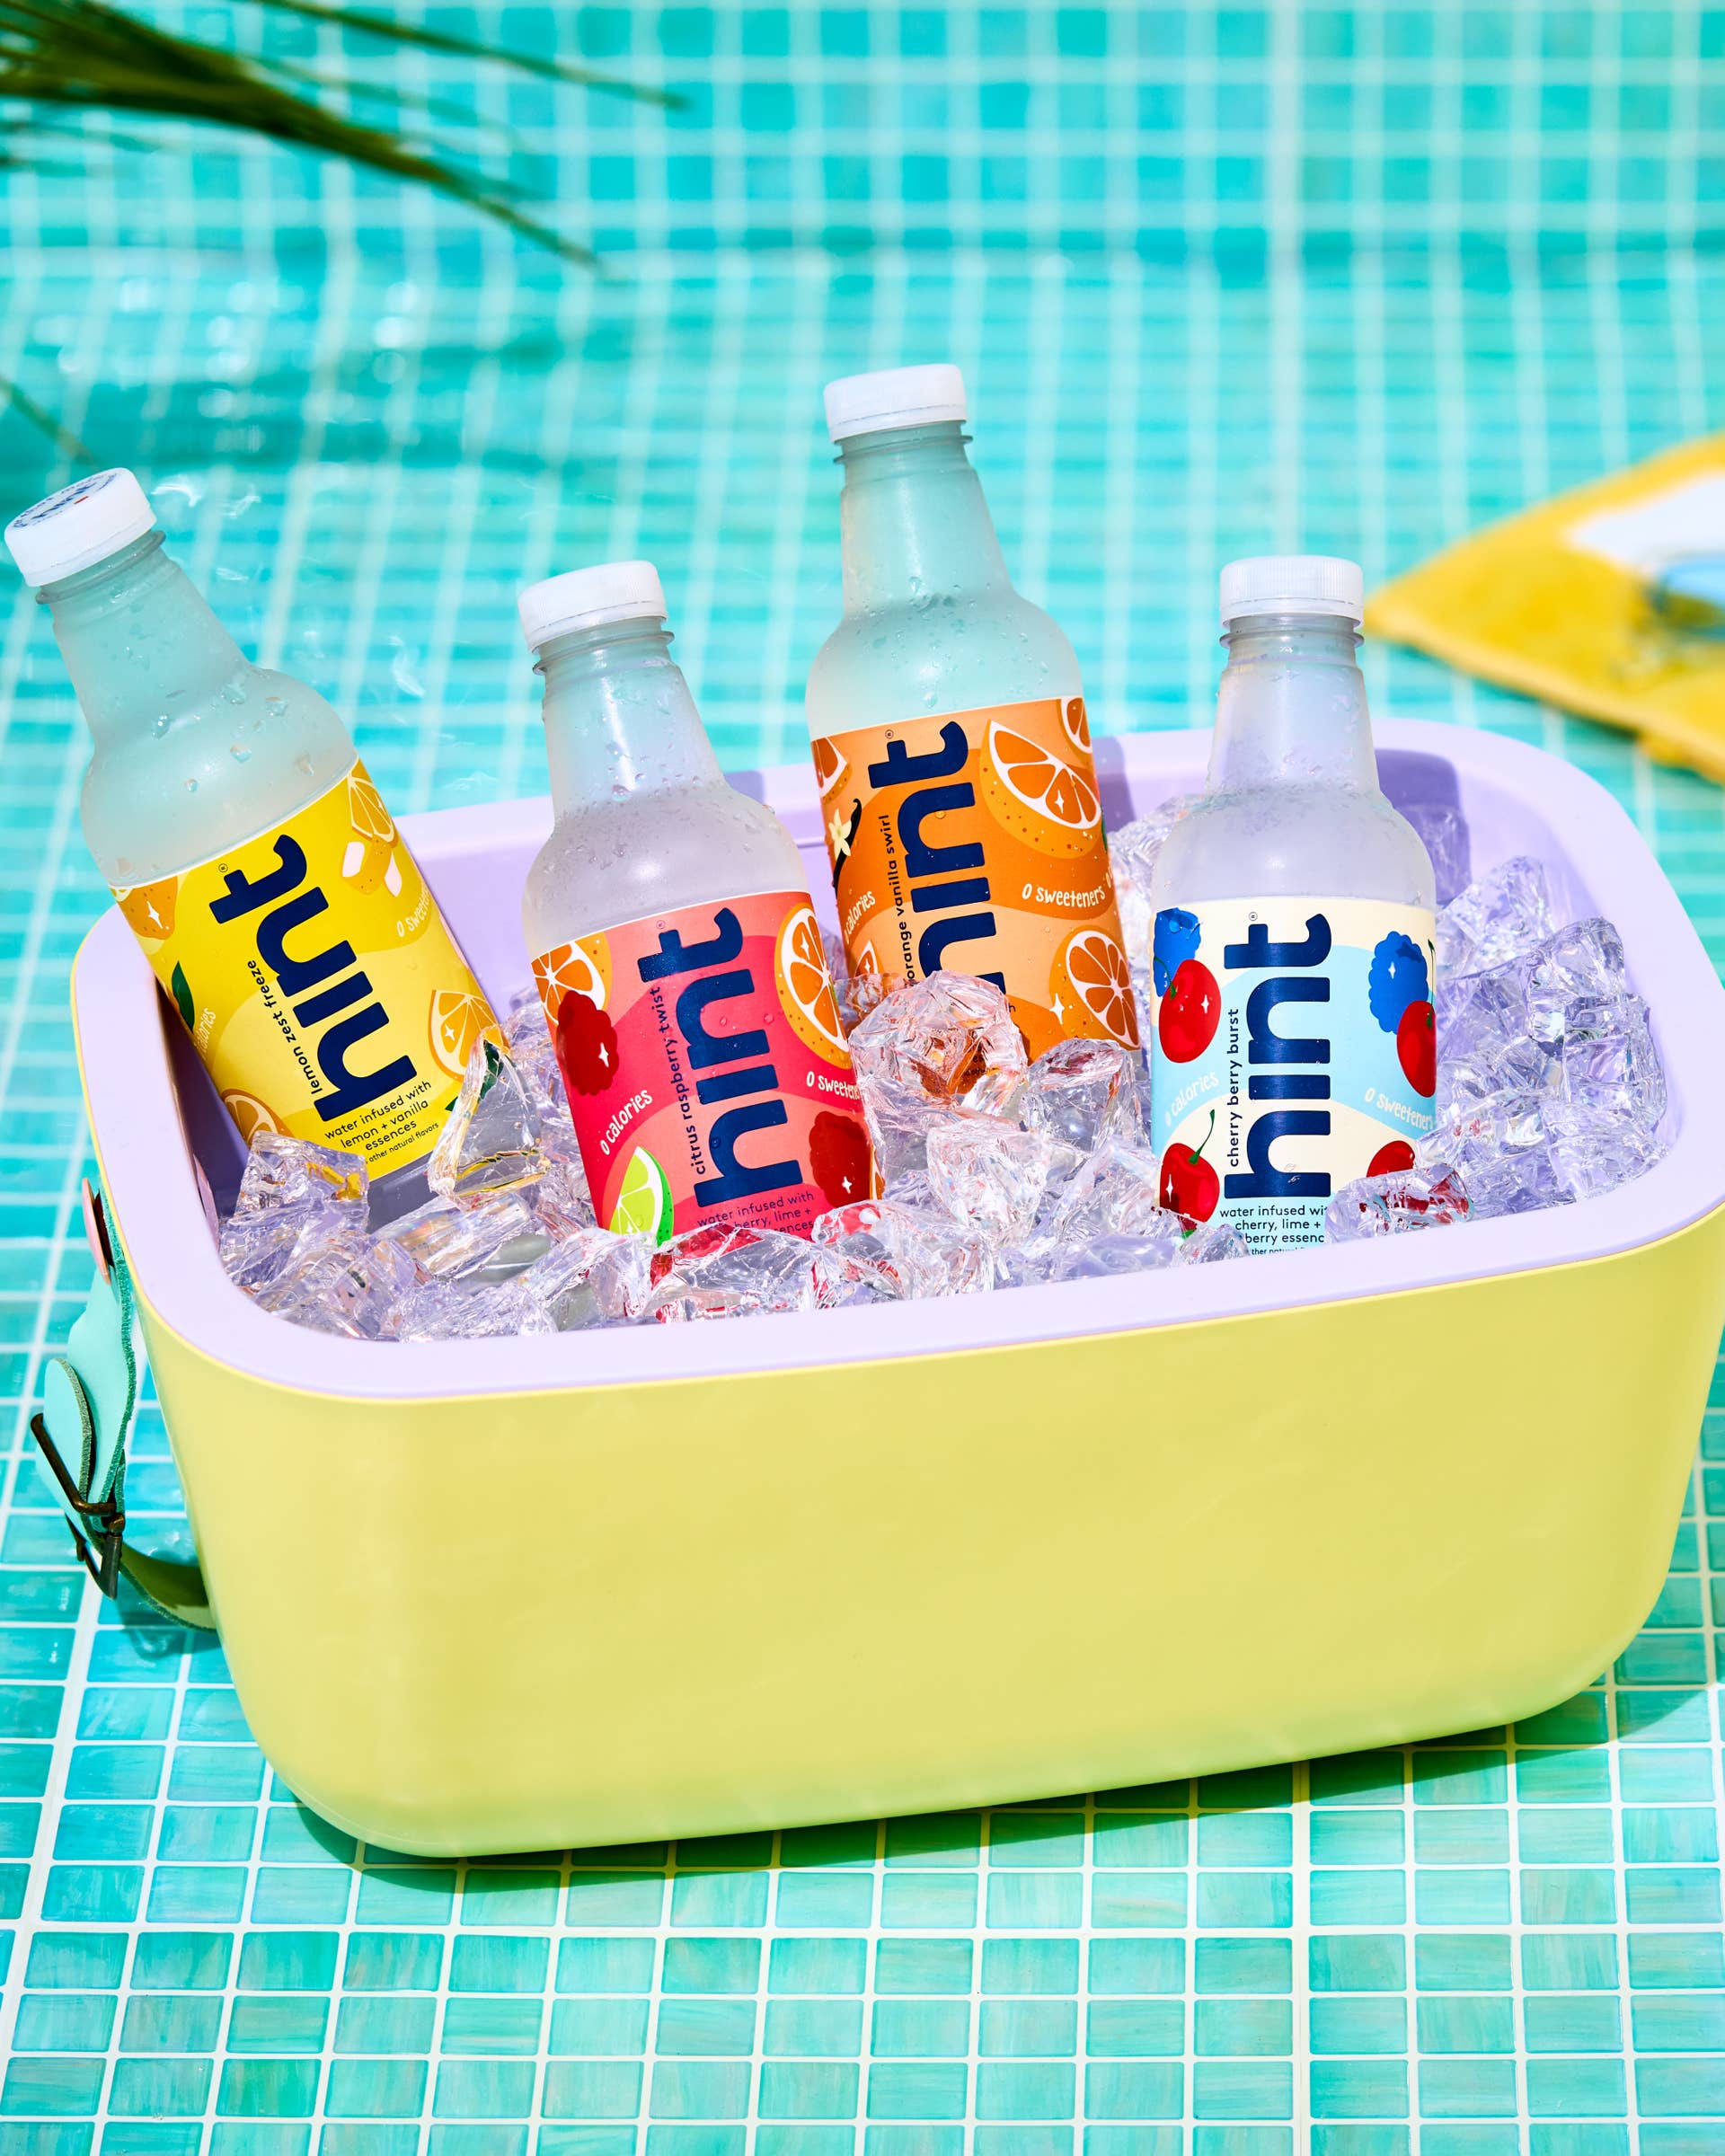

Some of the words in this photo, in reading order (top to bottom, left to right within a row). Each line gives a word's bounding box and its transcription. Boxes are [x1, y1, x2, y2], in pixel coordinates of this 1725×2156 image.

[878, 814, 895, 854] swirl
[887, 860, 905, 916] vanilla
[1022, 883, 1032, 900] 0
[1035, 885, 1105, 908] sweeteners
[396, 920, 405, 938] 0
[845, 890, 876, 935] calories
[898, 921, 915, 979] orange
[208, 834, 417, 1122] hint
[247, 959, 277, 1008] freeze
[272, 1011, 296, 1043] zest
[650, 986, 669, 1034] twist
[1227, 1008, 1239, 1055] burst
[293, 1046, 323, 1095] lemon
[637, 907, 803, 1207] hint
[664, 1038, 690, 1119] raspberry
[806, 1071, 815, 1087] 0
[1224, 913, 1331, 1198] hint
[1171, 1071, 1219, 1118] calories
[1227, 1059, 1243, 1106] berry
[1364, 1087, 1376, 1103] 0
[324, 1120, 358, 1139] water
[359, 1095, 404, 1125] infused
[405, 1081, 432, 1100] with
[341, 1127, 379, 1149] lemon
[390, 1100, 429, 1125] vanilla
[599, 1139, 610, 1156] 0
[606, 1090, 653, 1144] calories
[365, 1120, 417, 1151] essences
[368, 1151, 388, 1162] other
[389, 1135, 415, 1153] natural
[415, 1122, 439, 1139] flavors
[683, 1125, 706, 1175] citrus
[1227, 1111, 1243, 1167] cherry
[697, 1211, 733, 1227] water
[737, 1197, 784, 1216] infused
[787, 1191, 815, 1204] with
[735, 1216, 772, 1230] berry,
[774, 1208, 801, 1222] lime
[1220, 1206, 1254, 1217] water
[1258, 1205, 1305, 1216] infused
[1309, 1205, 1328, 1216] wi
[1235, 1220, 1278, 1233] cherry,
[1282, 1218, 1310, 1230] lime
[1314, 1221, 1321, 1229] +
[1245, 1233, 1278, 1245] berry
[1281, 1234, 1324, 1243] essenc
[1252, 1247, 1267, 1255] ther
